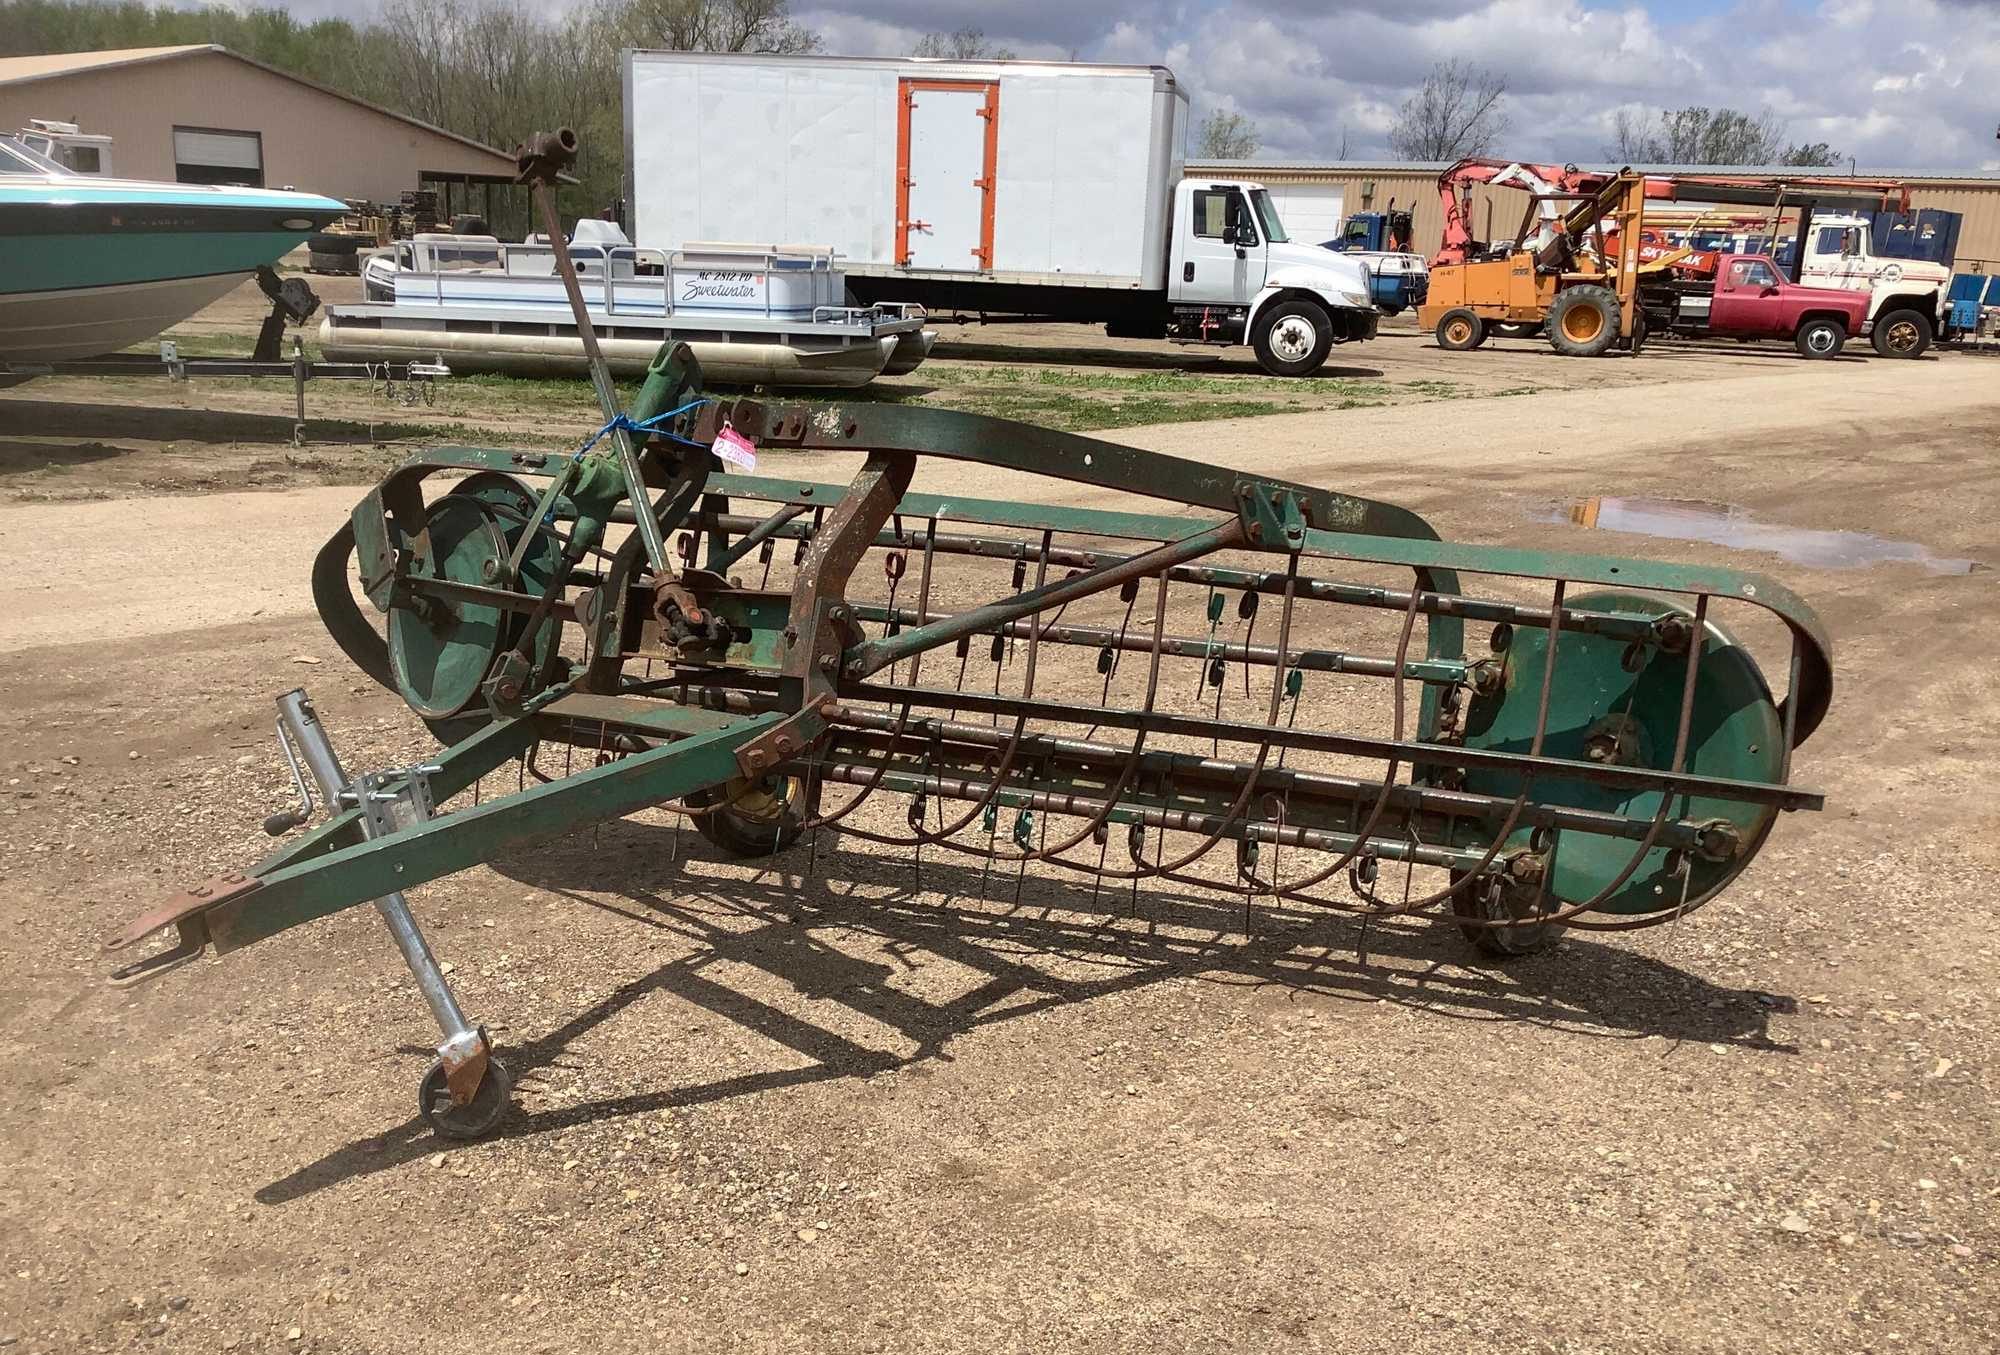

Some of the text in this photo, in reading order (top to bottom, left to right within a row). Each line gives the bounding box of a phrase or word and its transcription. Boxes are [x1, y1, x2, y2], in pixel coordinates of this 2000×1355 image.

[1640, 246, 1704, 266] SKYAK
[697, 271, 753, 282] MC 2812 PD
[682, 280, 757, 301] Sweetwater
